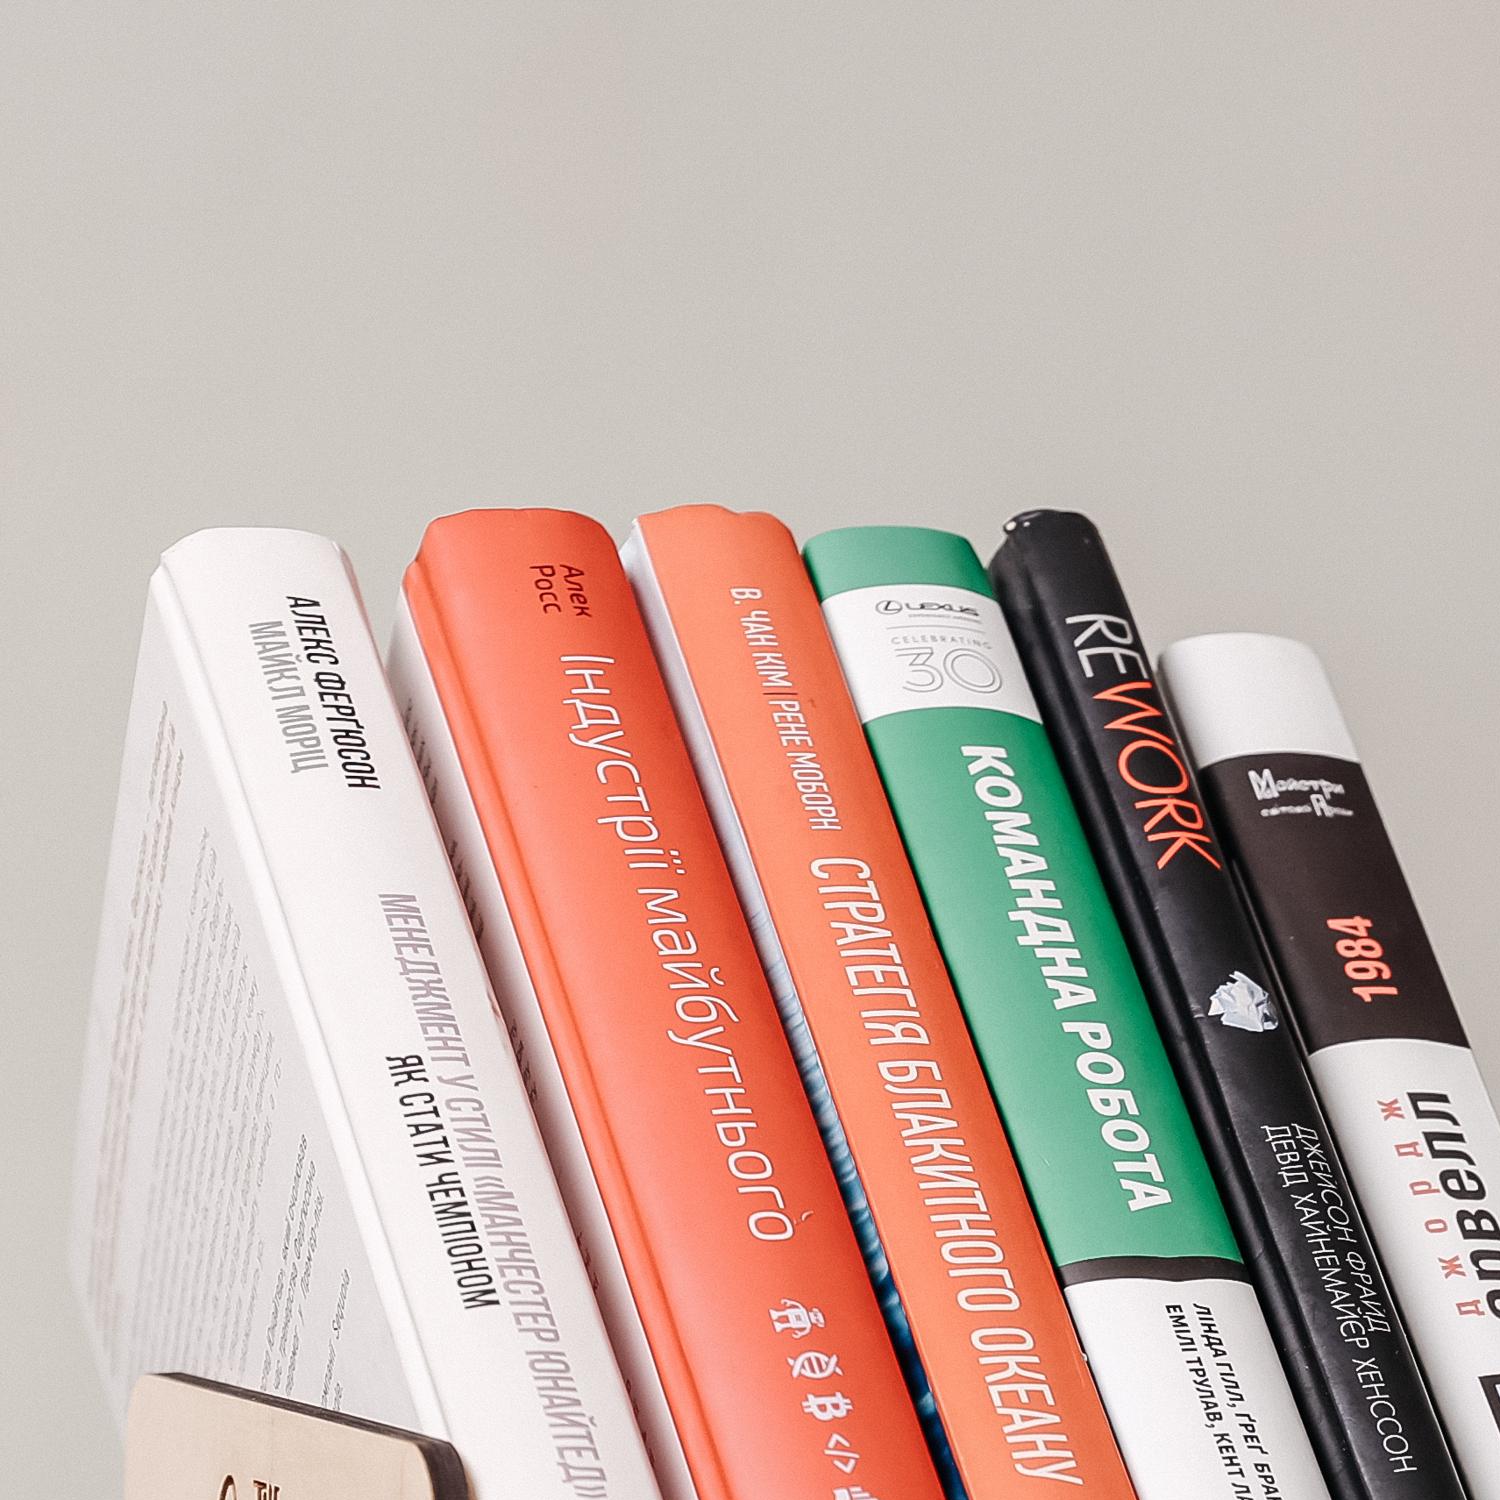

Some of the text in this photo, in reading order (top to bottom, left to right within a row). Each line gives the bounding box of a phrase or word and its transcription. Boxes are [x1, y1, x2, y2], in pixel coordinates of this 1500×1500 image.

[286, 595, 339, 665] АЛЕКС
[530, 564, 561, 614] Росс
[560, 563, 592, 618] Алек
[894, 647, 1002, 694] 30
[248, 620, 329, 774] МАЙКЛ МОРІЦ
[730, 587, 842, 830] В. ЧАН КІМ РЕНЕ МОБОРН
[1065, 614, 1222, 870] REWORK
[378, 893, 470, 1067] МЕНЕДЖМЕНТ
[560, 655, 794, 1241] Індустрії майбутнього
[961, 745, 1172, 1212] КОМАНДНА РОБОТА
[1326, 915, 1399, 1003] 1984
[436, 1074, 479, 1092] У
[444, 1098, 503, 1169] СТИЛІ
[386, 1054, 500, 1310] ЯК СТАТИ ЧЕМПІОНОМ
[809, 857, 1084, 1485] СТРАТЕГІЯ БЛАКИТНОГО ОКЕАНУ
[1291, 1122, 1391, 1334] ДЖЕЙСОН ФРАЙД
[473, 1174, 561, 1346] «МАНЧЕСТЕР
[1260, 1123, 1418, 1473] ДЕВІД ХАЙНЕМАЙЄР ХЕНССОН
[525, 1350, 607, 1499] ЮНАЙТЕД»
[1165, 1304, 1196, 1352] ЕМІЛІ
[1185, 1356, 1222, 1429] ТРУЛАВ,
[1212, 1432, 1245, 1478] КЕНТ
[1193, 1303, 1227, 1359] ЛІНДА
[1215, 1362, 1245, 1408] ГІЛЛ,
